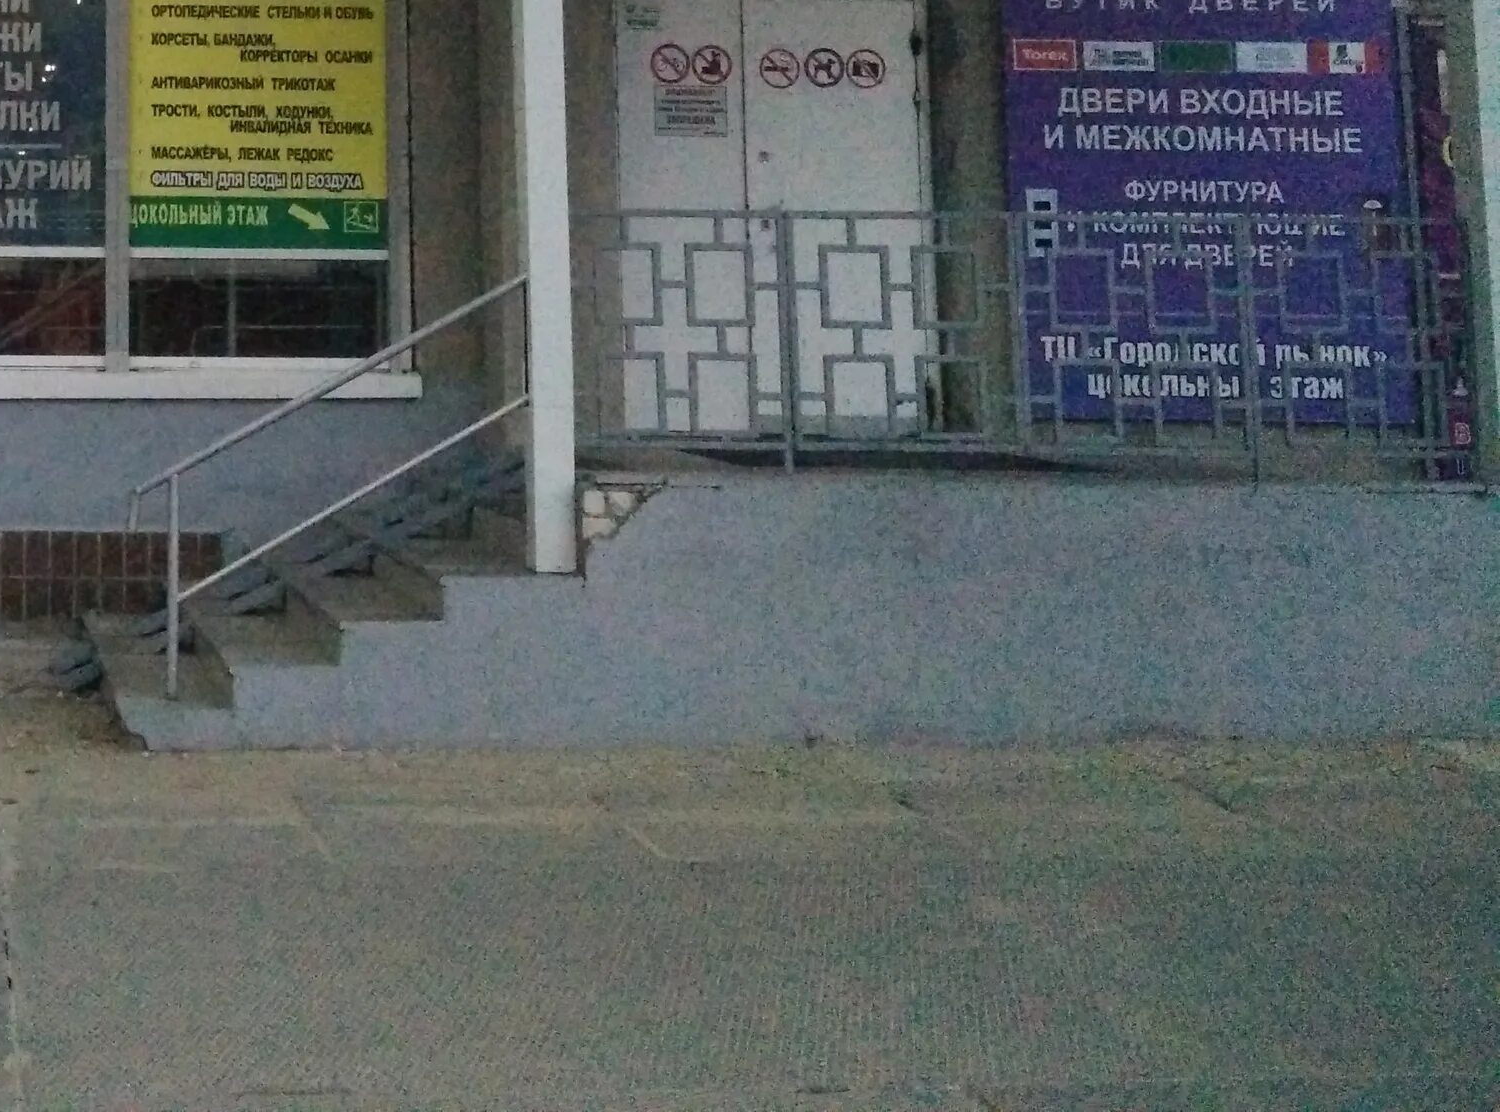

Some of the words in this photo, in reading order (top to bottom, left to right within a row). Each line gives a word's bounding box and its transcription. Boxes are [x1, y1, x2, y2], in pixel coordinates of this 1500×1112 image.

[151, 4, 261, 20] ОРТОПЕДИЧЕСКИЕ
[267, 6, 320, 19] СТЕЛЬКИ
[335, 6, 374, 20] ОБУВЬ
[239, 49, 319, 64] КОРРЕКТОРЫ
[324, 49, 373, 64] ОСАНКИ
[150, 75, 265, 91] АНТИВАРИКОЗНЫЙ
[271, 77, 337, 92] ТРИКОТАЖ
[1057, 87, 1170, 118] ДВЕРИ
[1179, 88, 1345, 120] ВХОДНЫЕ
[229, 119, 312, 136] ИНВАЛИДНАЯ
[318, 121, 374, 136] ТЕХНИКА
[1043, 123, 1066, 151] И
[1075, 124, 1364, 155] МЕЖКОМНАТНЫЕ
[237, 146, 281, 161] ЛЕЖАК
[286, 147, 334, 164] РЕДОКС
[150, 170, 213, 189] ФИЛЬТРЫ
[216, 171, 245, 191] ДЛЯ
[248, 172, 287, 191] ВОДЫ
[291, 172, 302, 189] И
[306, 172, 364, 192] ВОЗДУХА
[1123, 178, 1286, 205] ФУРНИТУРА
[226, 204, 270, 226] ЭТАЖ
